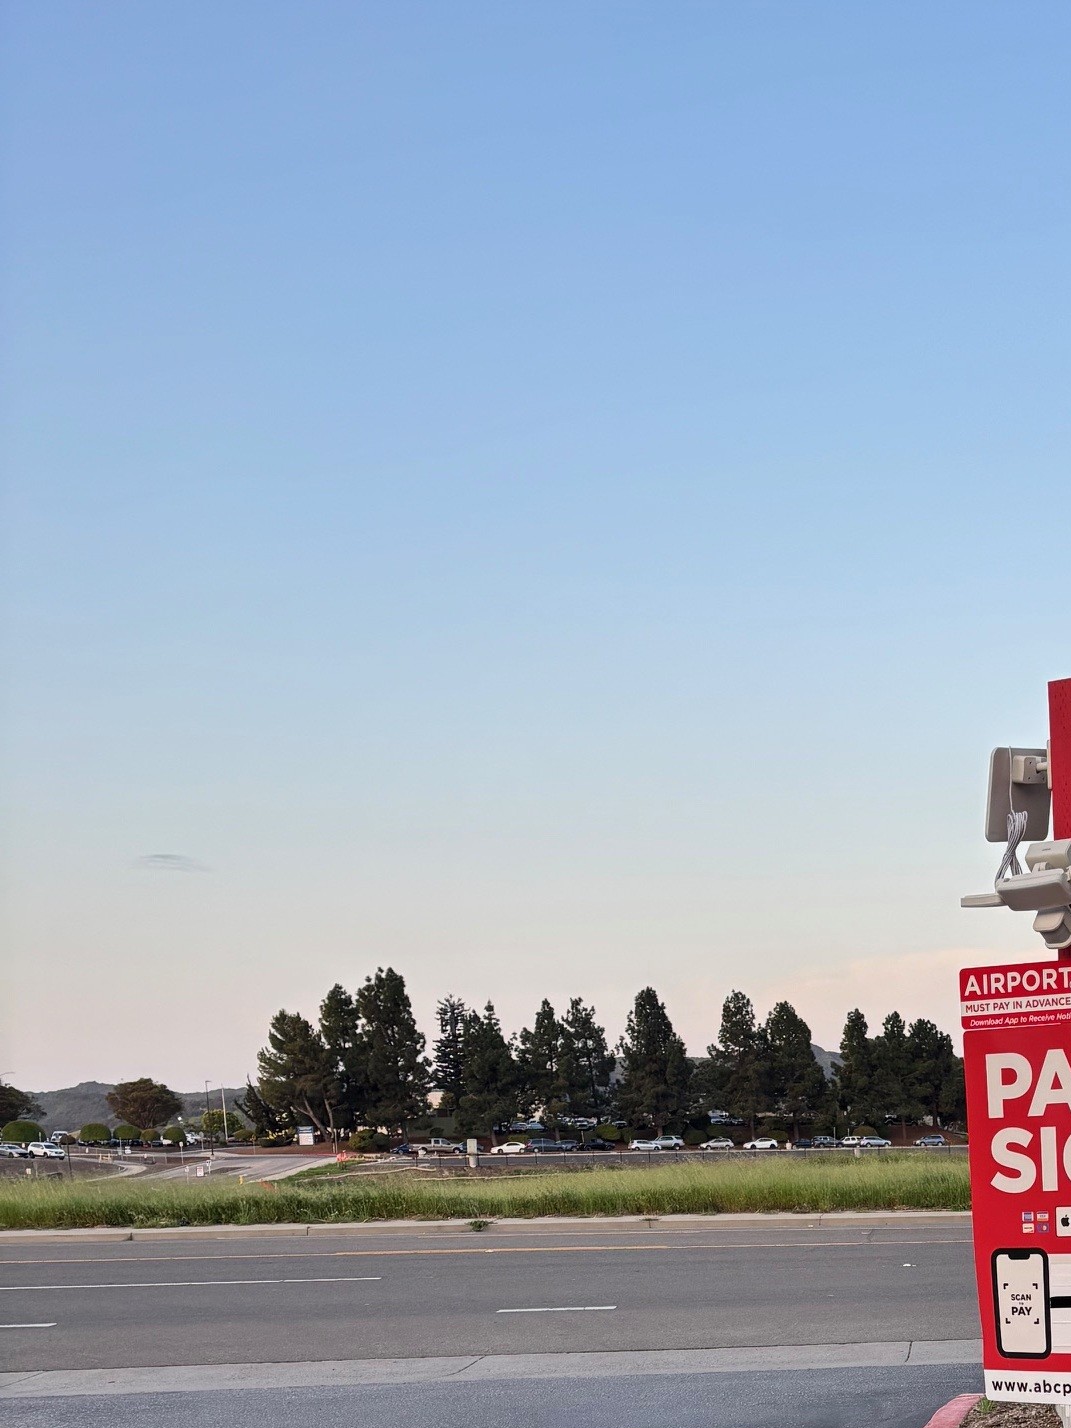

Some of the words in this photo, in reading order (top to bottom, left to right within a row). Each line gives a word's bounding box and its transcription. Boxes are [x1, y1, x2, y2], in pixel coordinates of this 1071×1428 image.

[964, 966, 1071, 997] AIRPORT
[965, 1003, 991, 1013] MUST
[993, 1001, 1010, 1012] PAY
[1012, 1000, 1023, 1009] IN
[1025, 997, 1071, 1009] ADVANCE
[970, 1017, 1003, 1027] Download
[1004, 1016, 1019, 1025] App
[1020, 1015, 1028, 1023] to
[1028, 1013, 1056, 1023] Receive
[1011, 1293, 1032, 1301] SCAN
[1011, 1306, 1032, 1316] PAY
